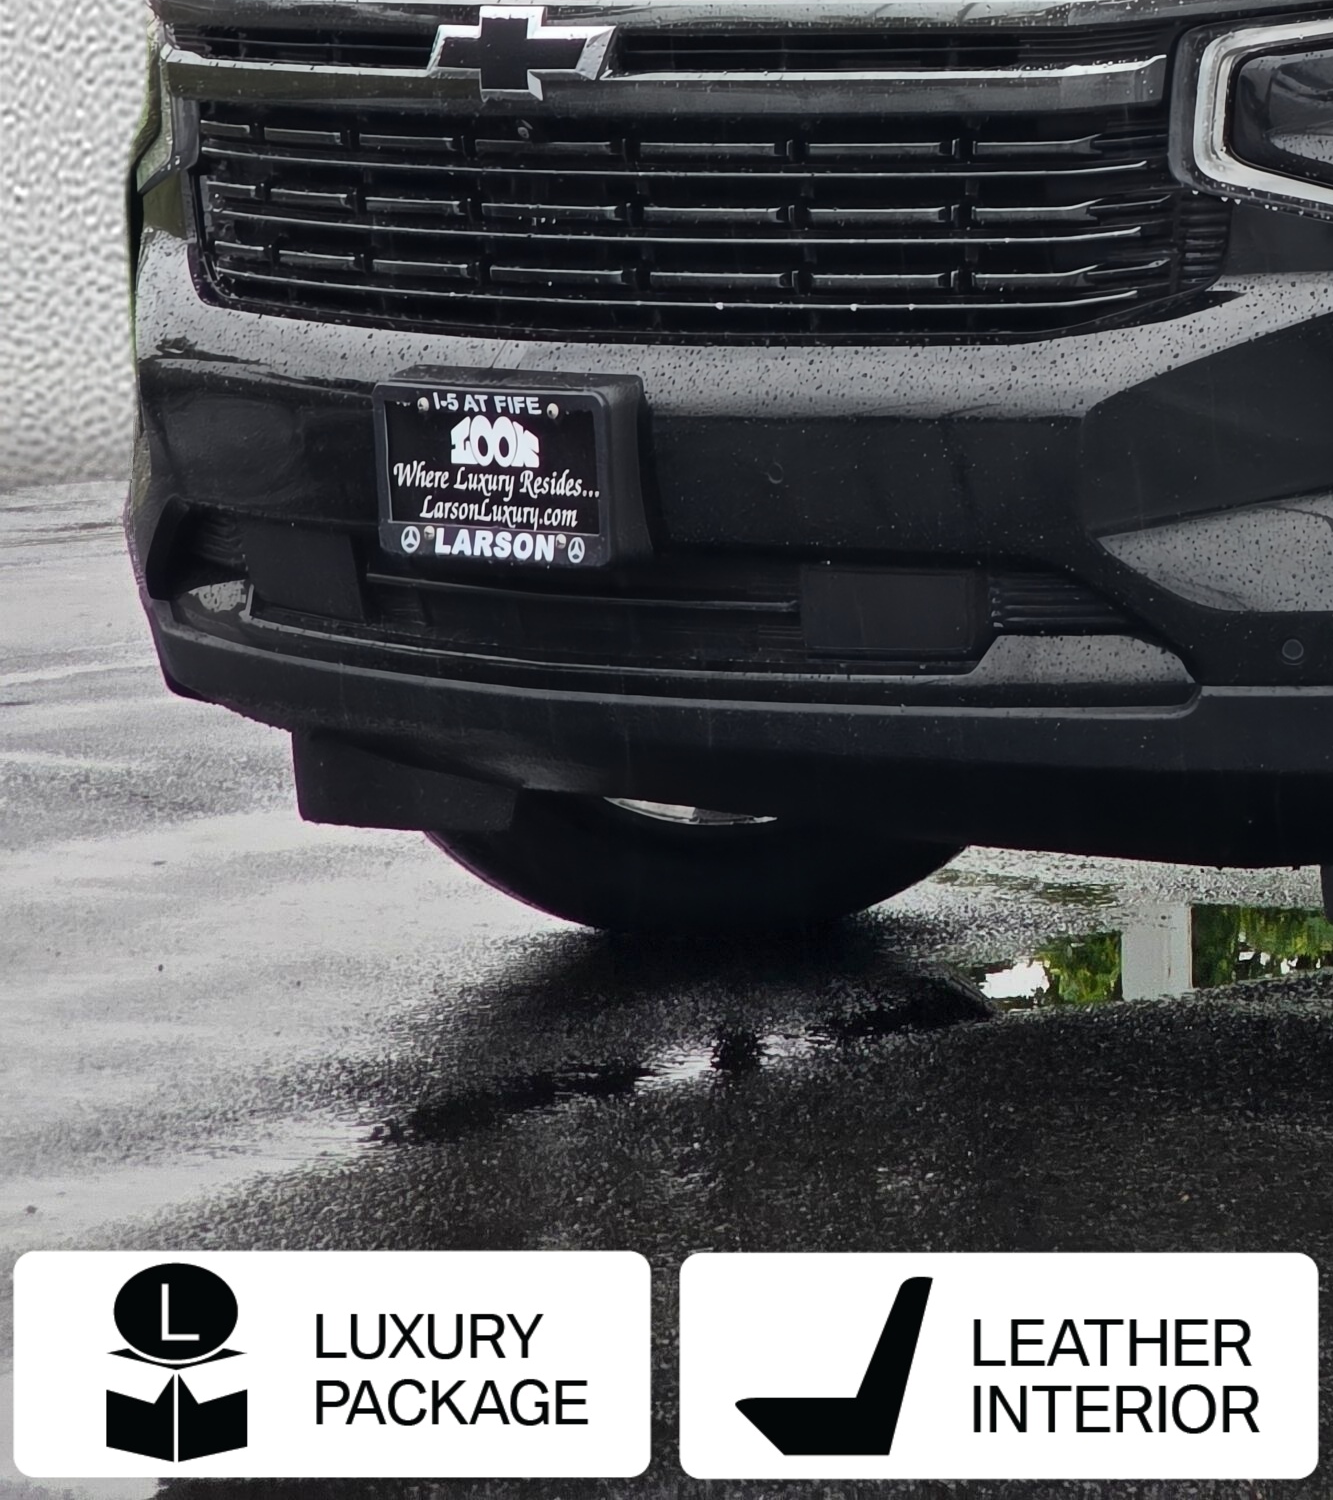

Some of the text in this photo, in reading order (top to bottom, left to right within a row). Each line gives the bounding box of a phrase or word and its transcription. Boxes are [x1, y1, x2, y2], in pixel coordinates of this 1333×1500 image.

[463, 394, 488, 412] AT
[493, 395, 542, 415] FIFE
[393, 461, 600, 502] Where Luxury Resides...
[419, 495, 578, 531] LarsonLuxury.com
[434, 527, 556, 562] LARSON
